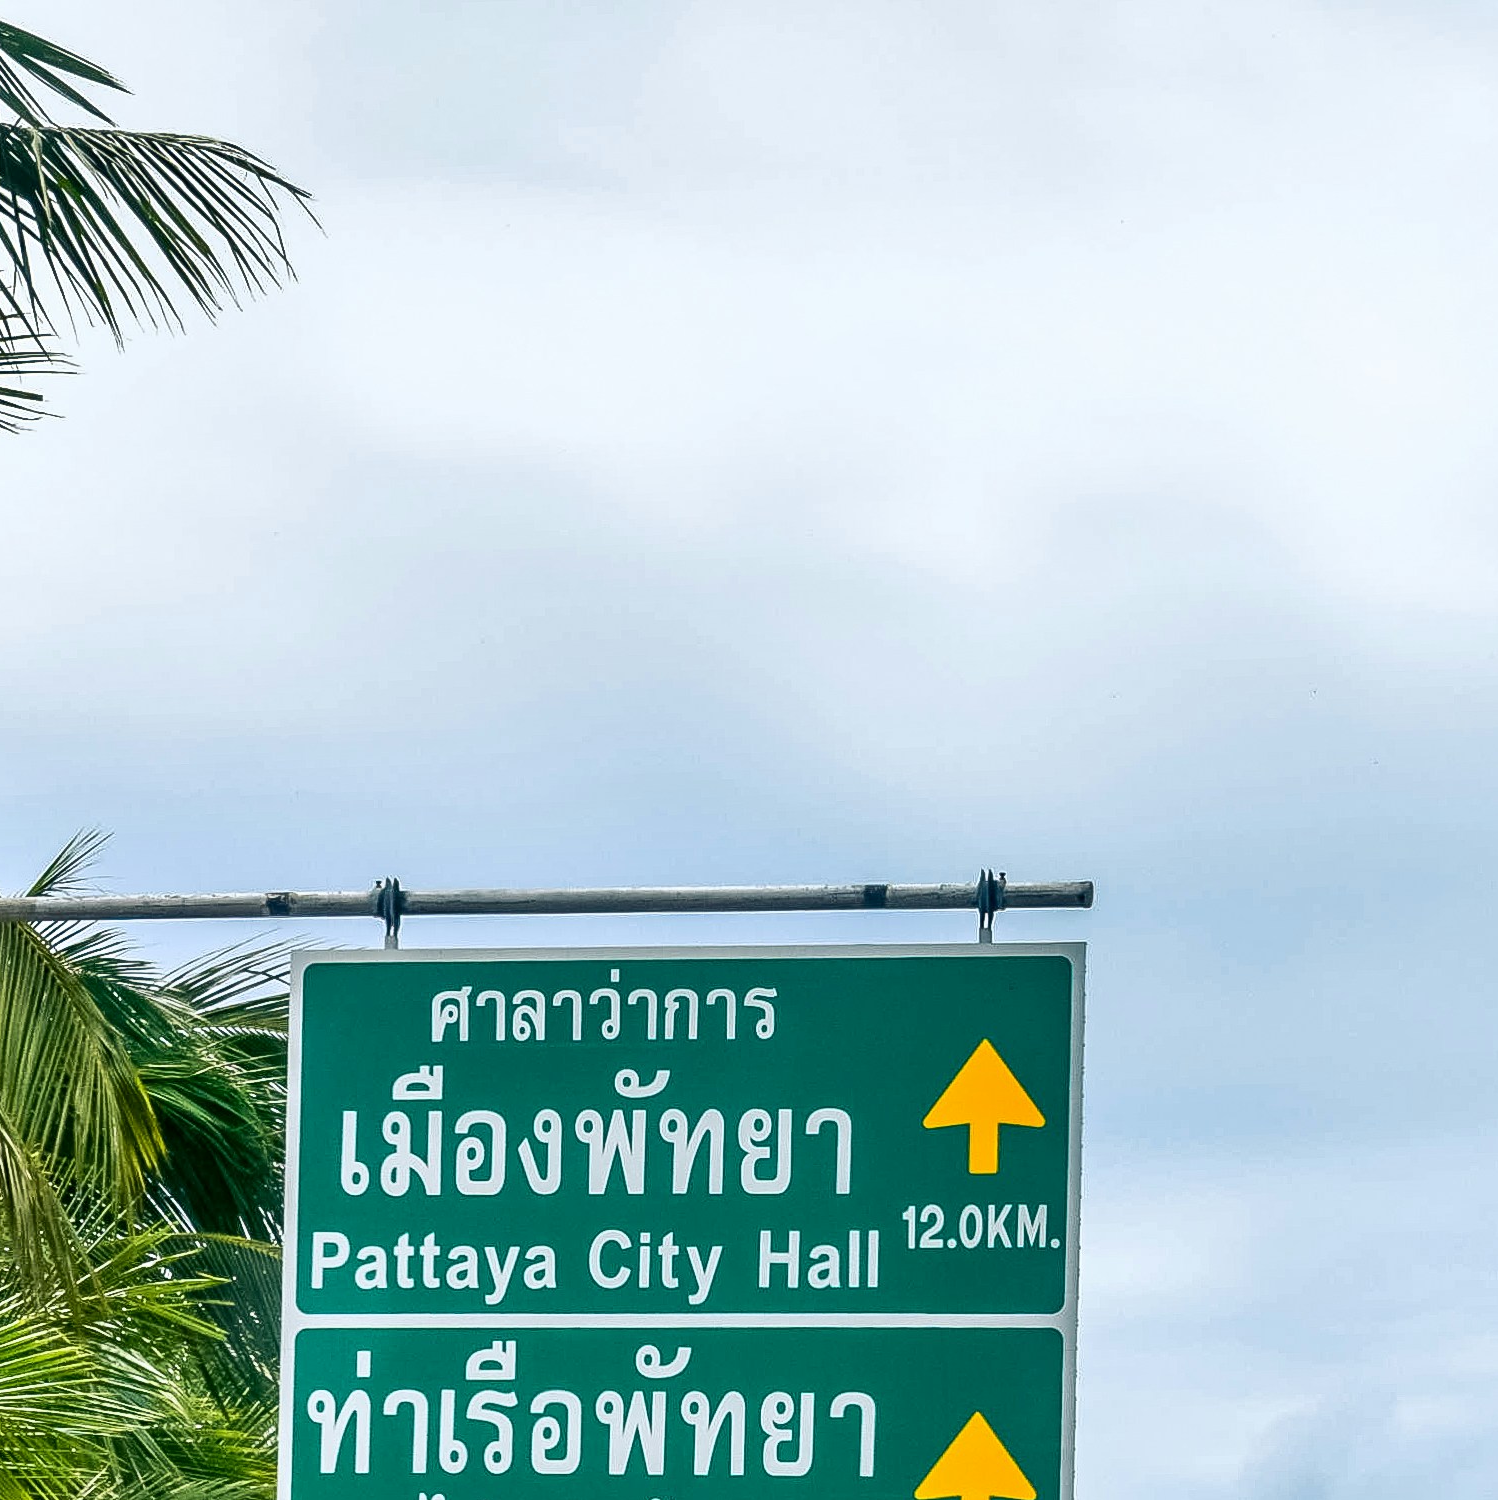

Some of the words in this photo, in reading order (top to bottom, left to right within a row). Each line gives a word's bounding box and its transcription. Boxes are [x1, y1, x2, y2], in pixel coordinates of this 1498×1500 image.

[430, 969, 779, 1043] ศาลาว่าการ
[340, 1065, 853, 1197] เมืองพัทยา
[902, 1204, 1061, 1250] 12.0KM.
[311, 1231, 557, 1305] Pattaya
[589, 1230, 722, 1305] City
[758, 1230, 880, 1290] Hall
[307, 1340, 876, 1478] ท่าเรือพัทยา
